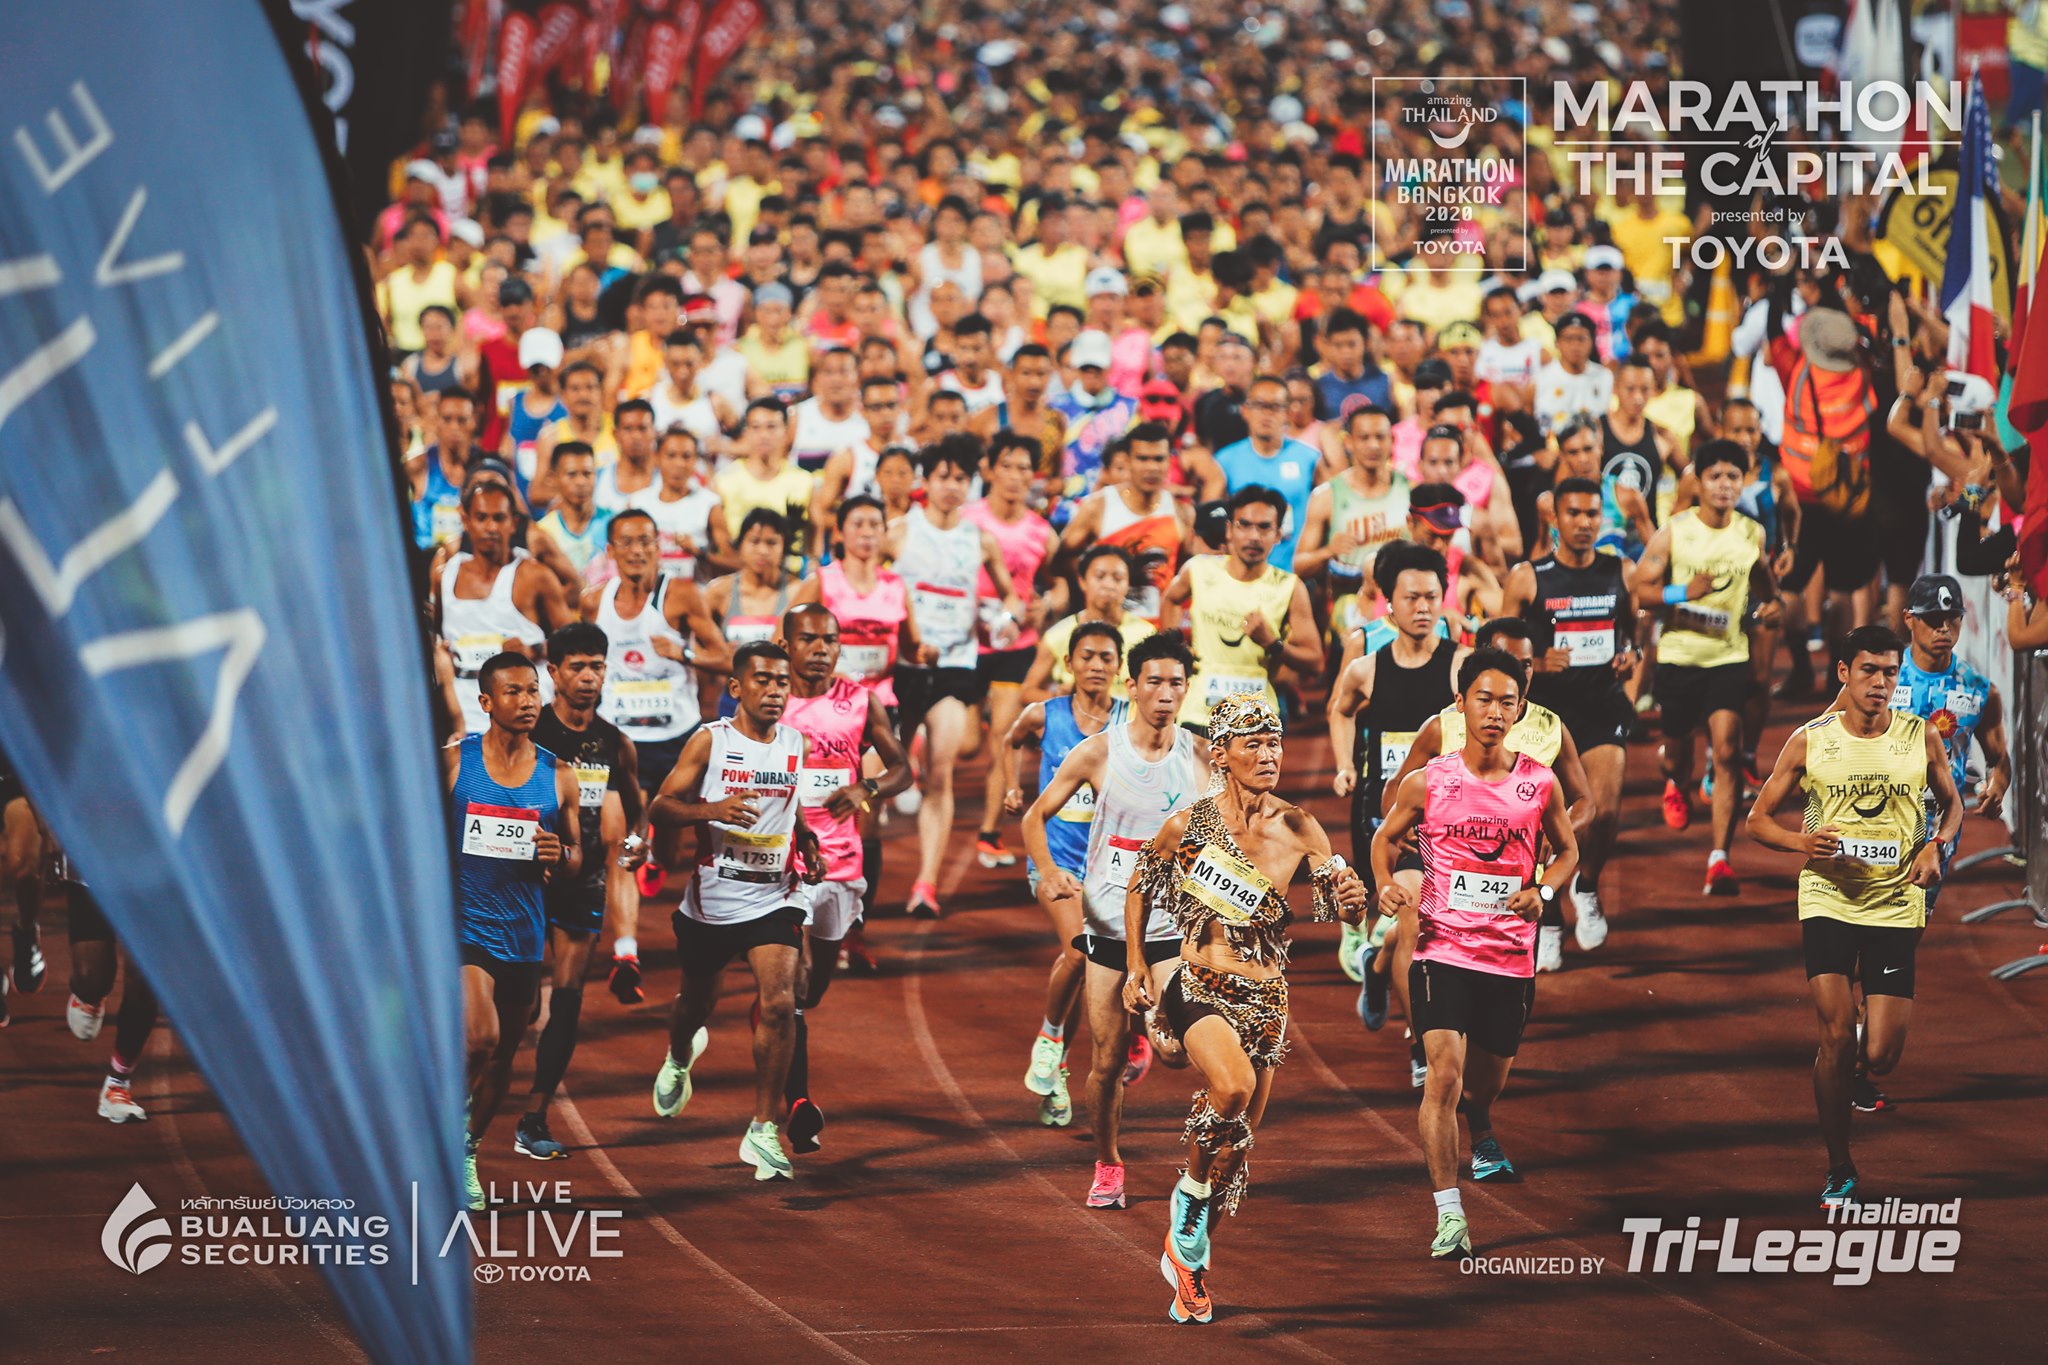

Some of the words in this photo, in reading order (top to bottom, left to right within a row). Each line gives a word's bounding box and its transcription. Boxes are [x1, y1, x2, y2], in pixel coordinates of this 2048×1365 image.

[1581, 636, 1604, 648] 260
[616, 698, 624, 709] A
[1889, 743, 1913, 752] ALIVE
[1386, 749, 1396, 762] A
[814, 775, 839, 788] 254
[1848, 772, 1890, 783] amazing
[1826, 783, 1911, 798] THAILAND
[1467, 816, 1509, 828] amazing
[470, 819, 482, 835] A
[496, 824, 525, 839] 250
[1443, 824, 1528, 842] THAILAND
[723, 846, 735, 861] A
[742, 851, 781, 865] 17931
[1835, 840, 1846, 855] A
[1852, 845, 1897, 859] 13340
[1111, 851, 1121, 867] A
[1454, 875, 1467, 891] A
[1480, 880, 1509, 895] 242
[1471, 901, 1499, 910] TOYOTA
